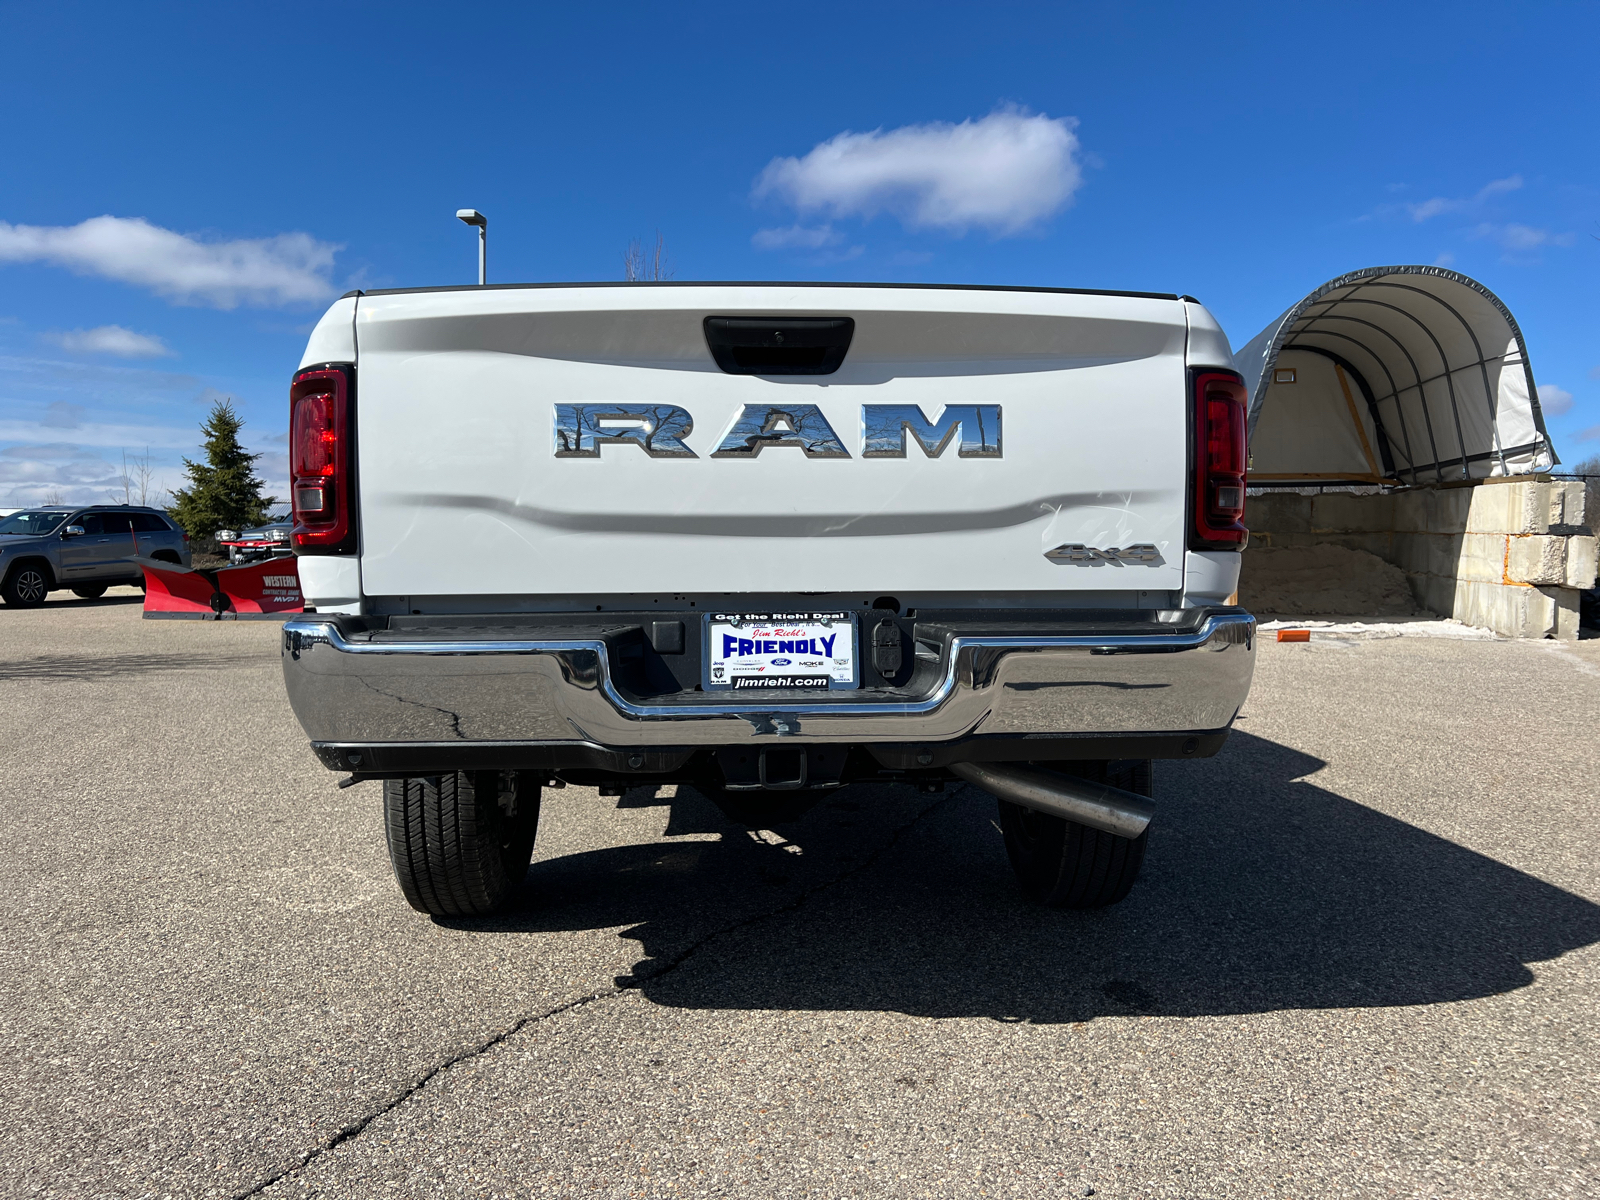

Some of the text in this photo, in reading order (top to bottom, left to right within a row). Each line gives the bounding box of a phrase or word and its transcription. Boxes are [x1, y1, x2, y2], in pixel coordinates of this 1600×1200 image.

[553, 403, 1004, 459] RAM
[262, 575, 297, 587] WESTERN
[751, 628, 806, 639] Jim Riehl's
[723, 632, 837, 659] FRIENDLY
[734, 677, 827, 689] jimriehl.com
